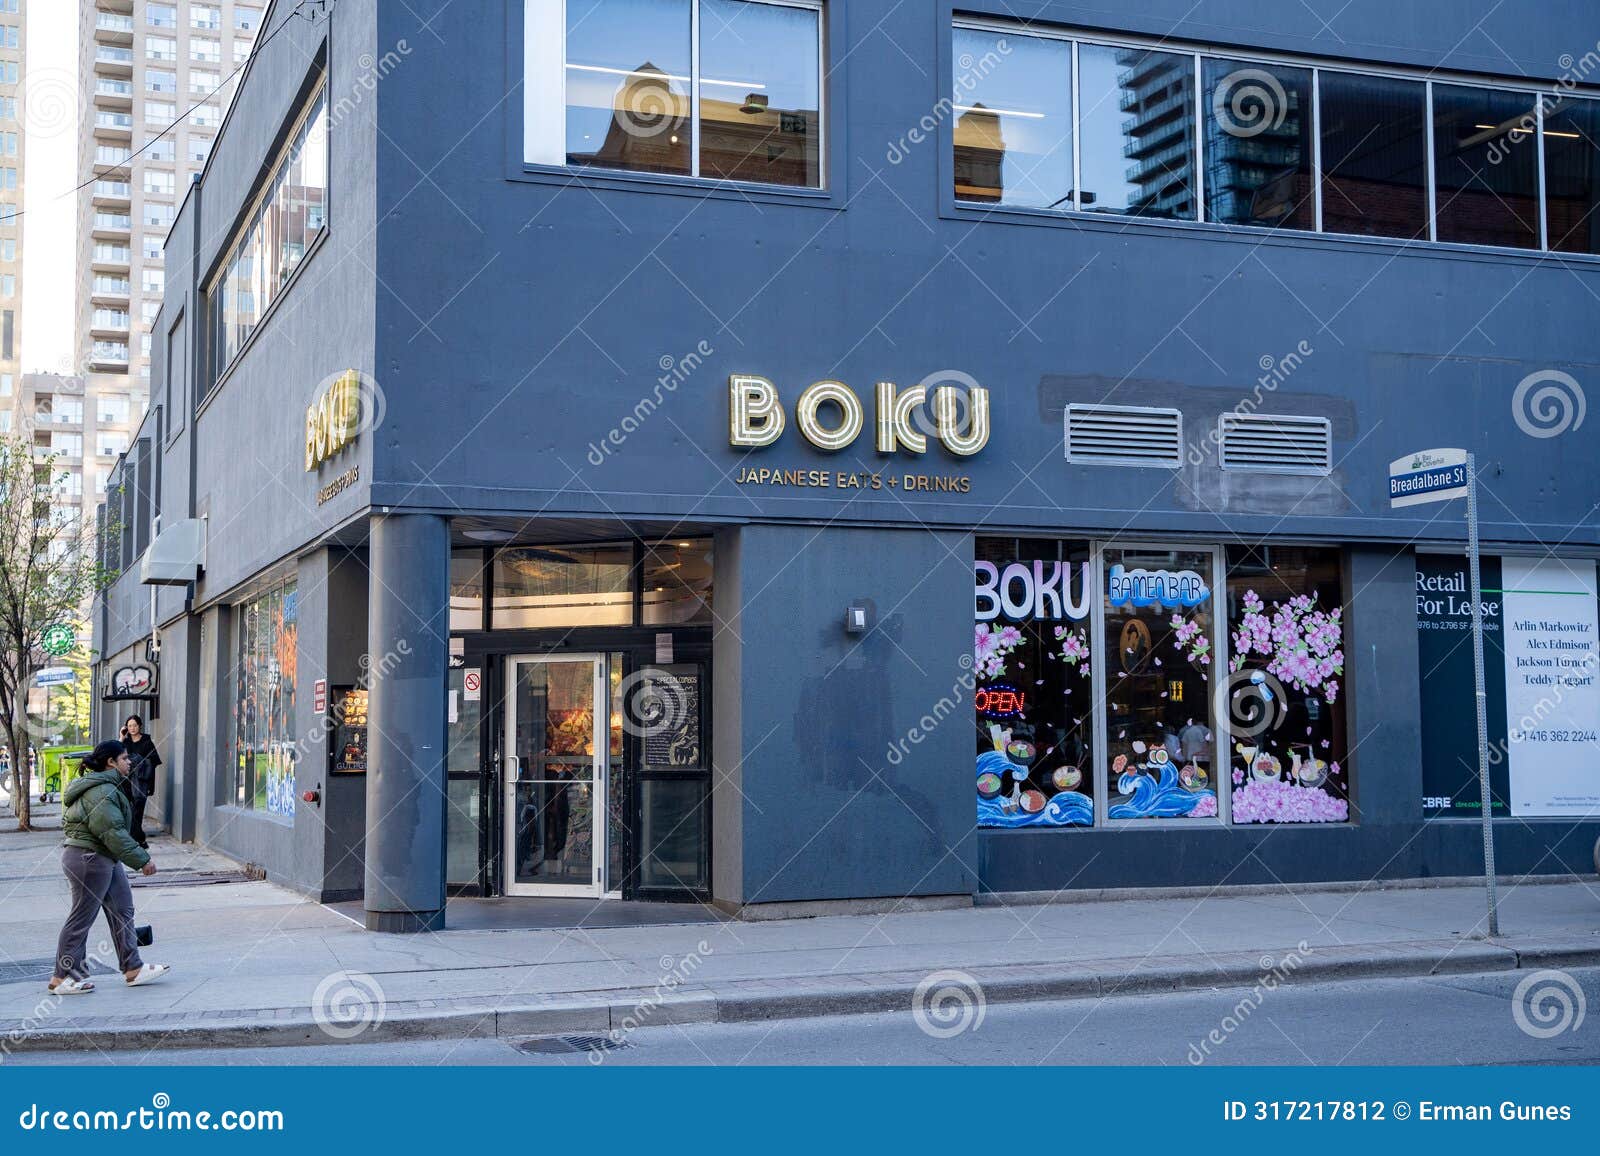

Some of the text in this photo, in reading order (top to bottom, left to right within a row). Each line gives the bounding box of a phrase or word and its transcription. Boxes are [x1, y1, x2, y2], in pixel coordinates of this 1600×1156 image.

[729, 374, 990, 455] BOKU
[736, 467, 970, 493] JAPANESE EATS + DRINKS
[1391, 468, 1464, 493] Breadalbane St
[975, 560, 1090, 620] BOKU
[1111, 576, 1202, 599] RAMEN BAR
[1416, 572, 1466, 592] Retail
[1416, 595, 1499, 616] For Lese
[1432, 621, 1439, 630] to
[1459, 621, 1468, 630] SF
[1513, 620, 1537, 631] Arlin
[1527, 639, 1547, 649] Alex
[1516, 656, 1552, 668] Jackson
[1523, 674, 1552, 687] Teddy
[975, 691, 1025, 711] OPEN
[1530, 731, 1548, 741] 416
[1550, 731, 1569, 742] 362
[1571, 731, 1597, 742] 2244
